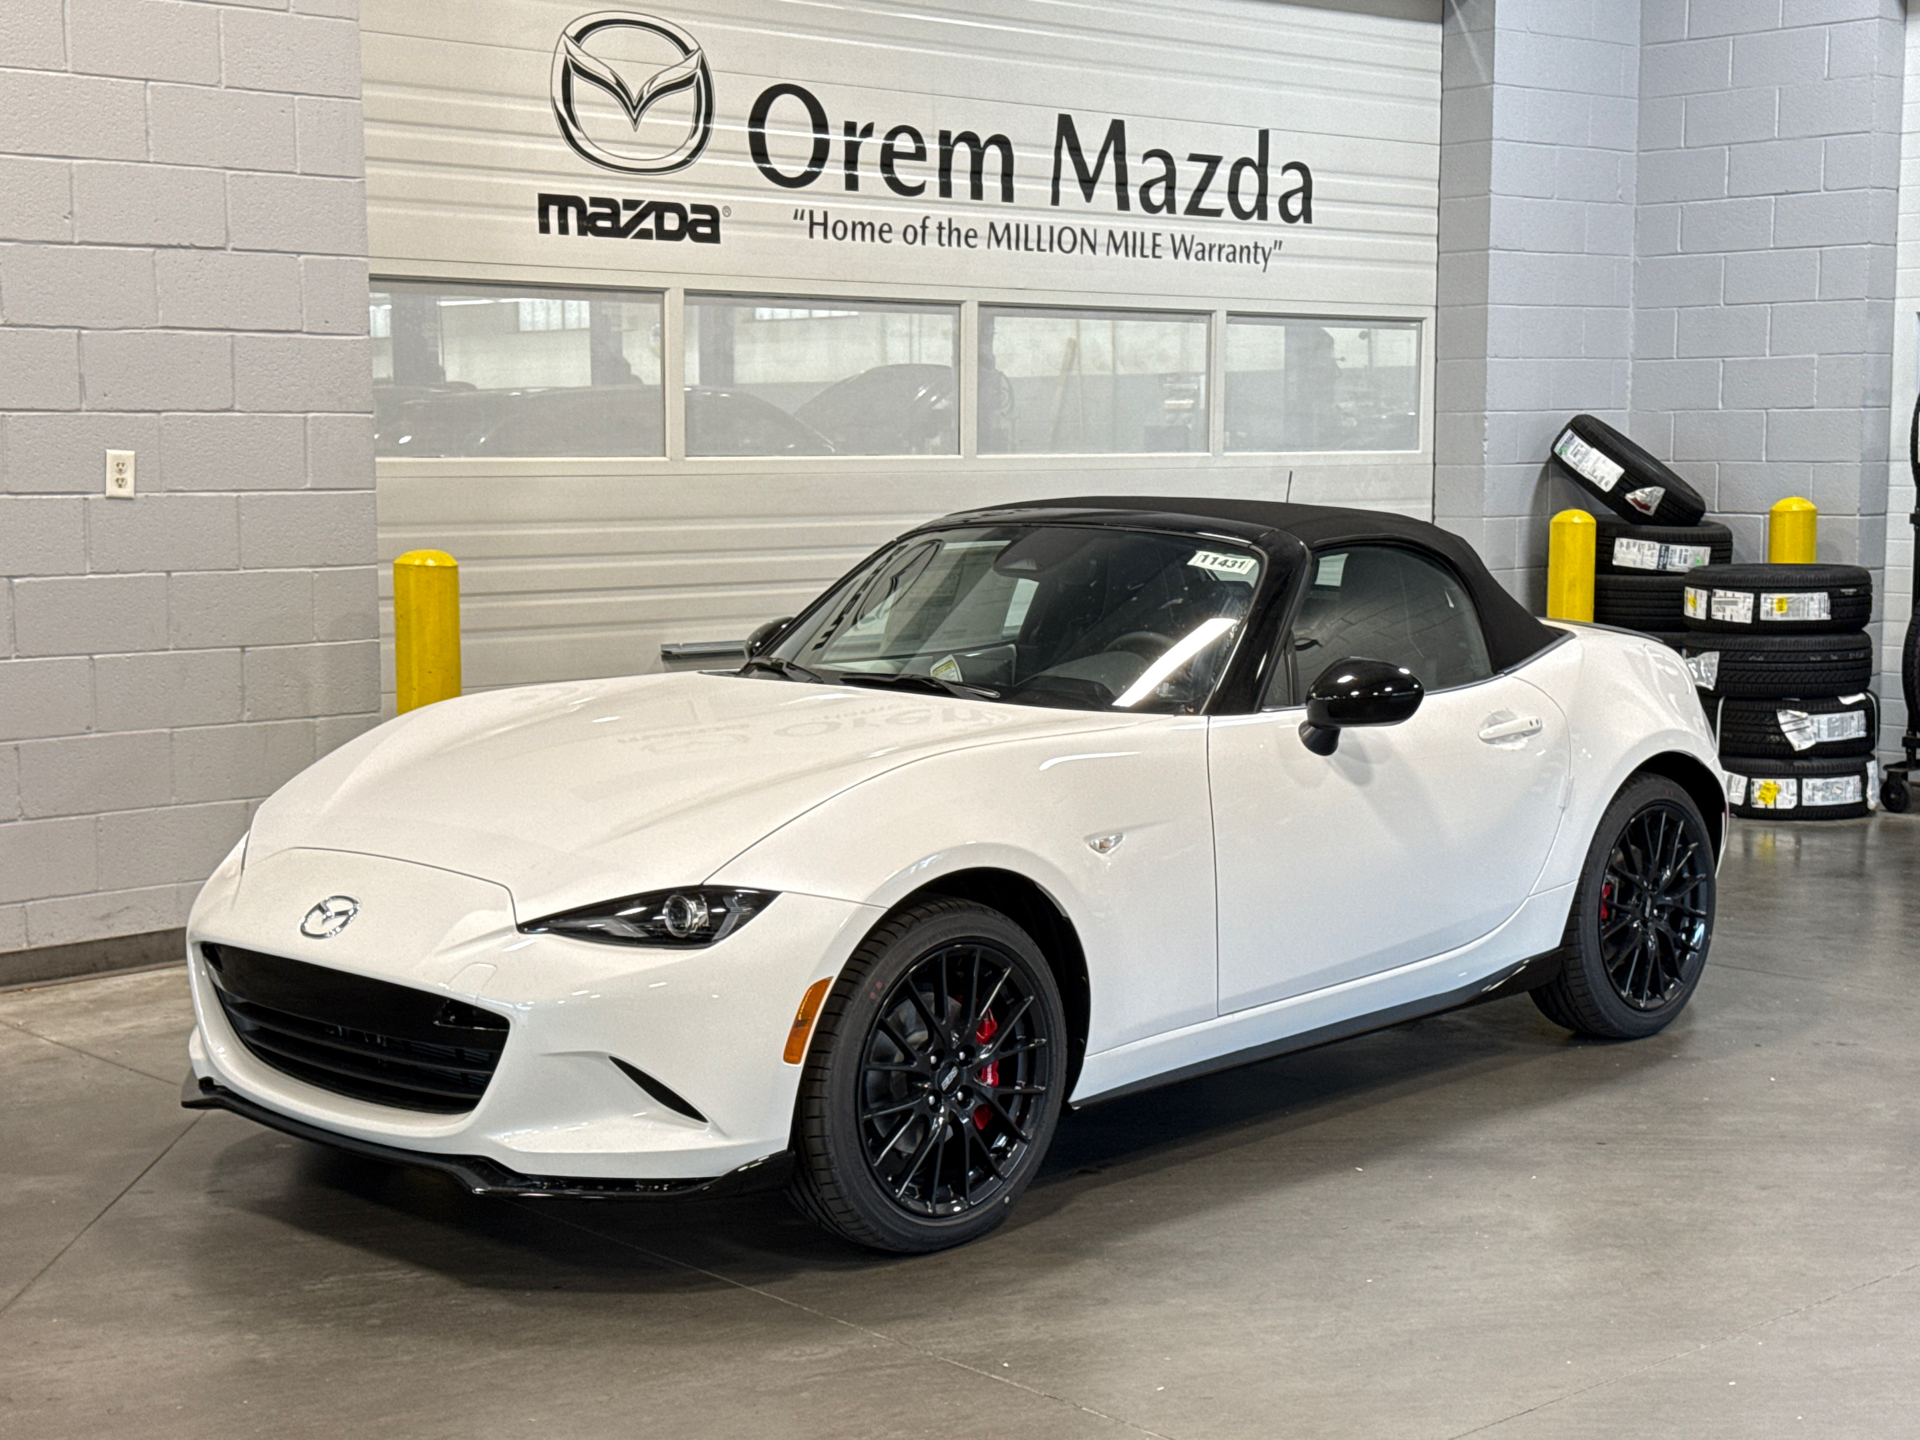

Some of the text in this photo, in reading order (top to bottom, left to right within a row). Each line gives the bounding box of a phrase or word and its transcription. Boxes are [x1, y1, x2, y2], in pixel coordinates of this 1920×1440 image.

[749, 83, 1313, 225] Orem Mazda
[793, 208, 893, 244] "Home
[902, 216, 930, 246] of
[936, 217, 979, 249] the
[986, 221, 1097, 256] MILLION
[1105, 229, 1163, 260] MILE
[1200, 553, 1247, 570] 11431
